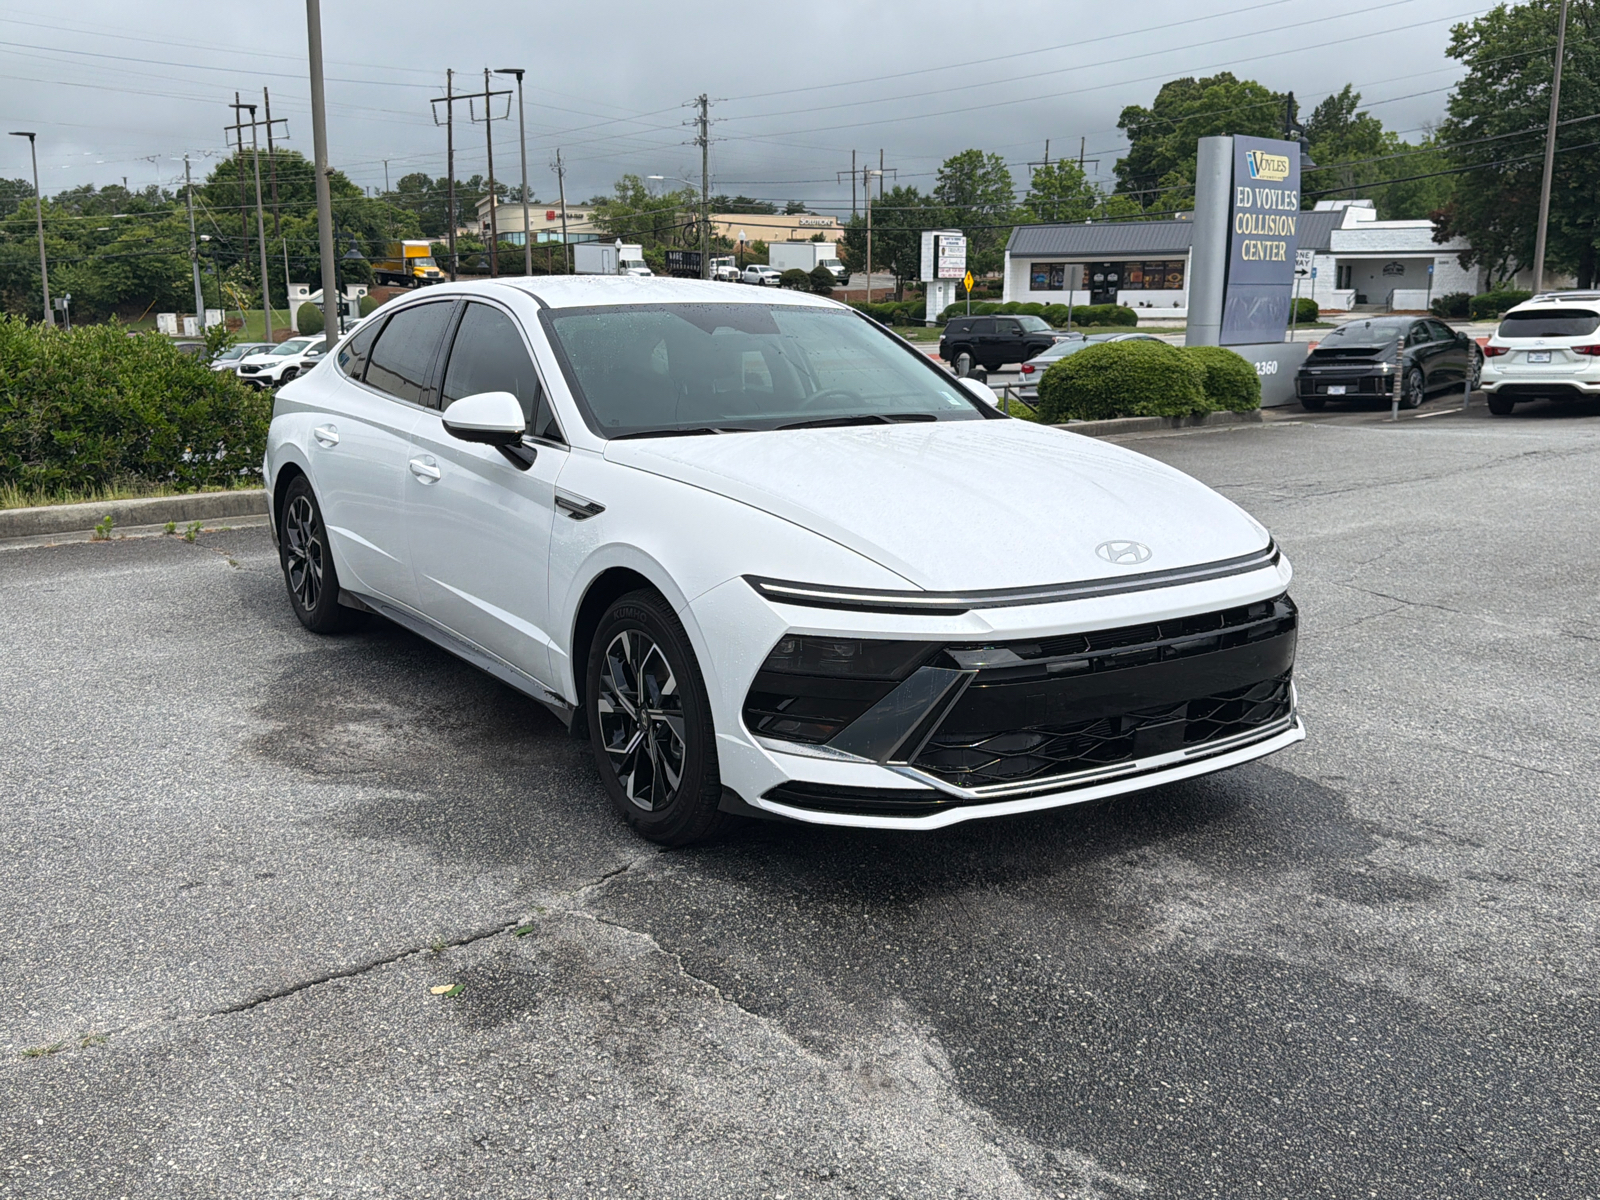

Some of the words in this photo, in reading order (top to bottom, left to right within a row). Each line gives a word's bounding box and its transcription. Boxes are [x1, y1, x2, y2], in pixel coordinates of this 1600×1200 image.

[1236, 187, 1253, 208] ED
[1255, 188, 1297, 211] VOYLES
[1235, 213, 1297, 236] COLLISION
[1241, 239, 1287, 261] CENTER
[1254, 360, 1278, 375] 2360
[613, 607, 647, 623] KUMHO
